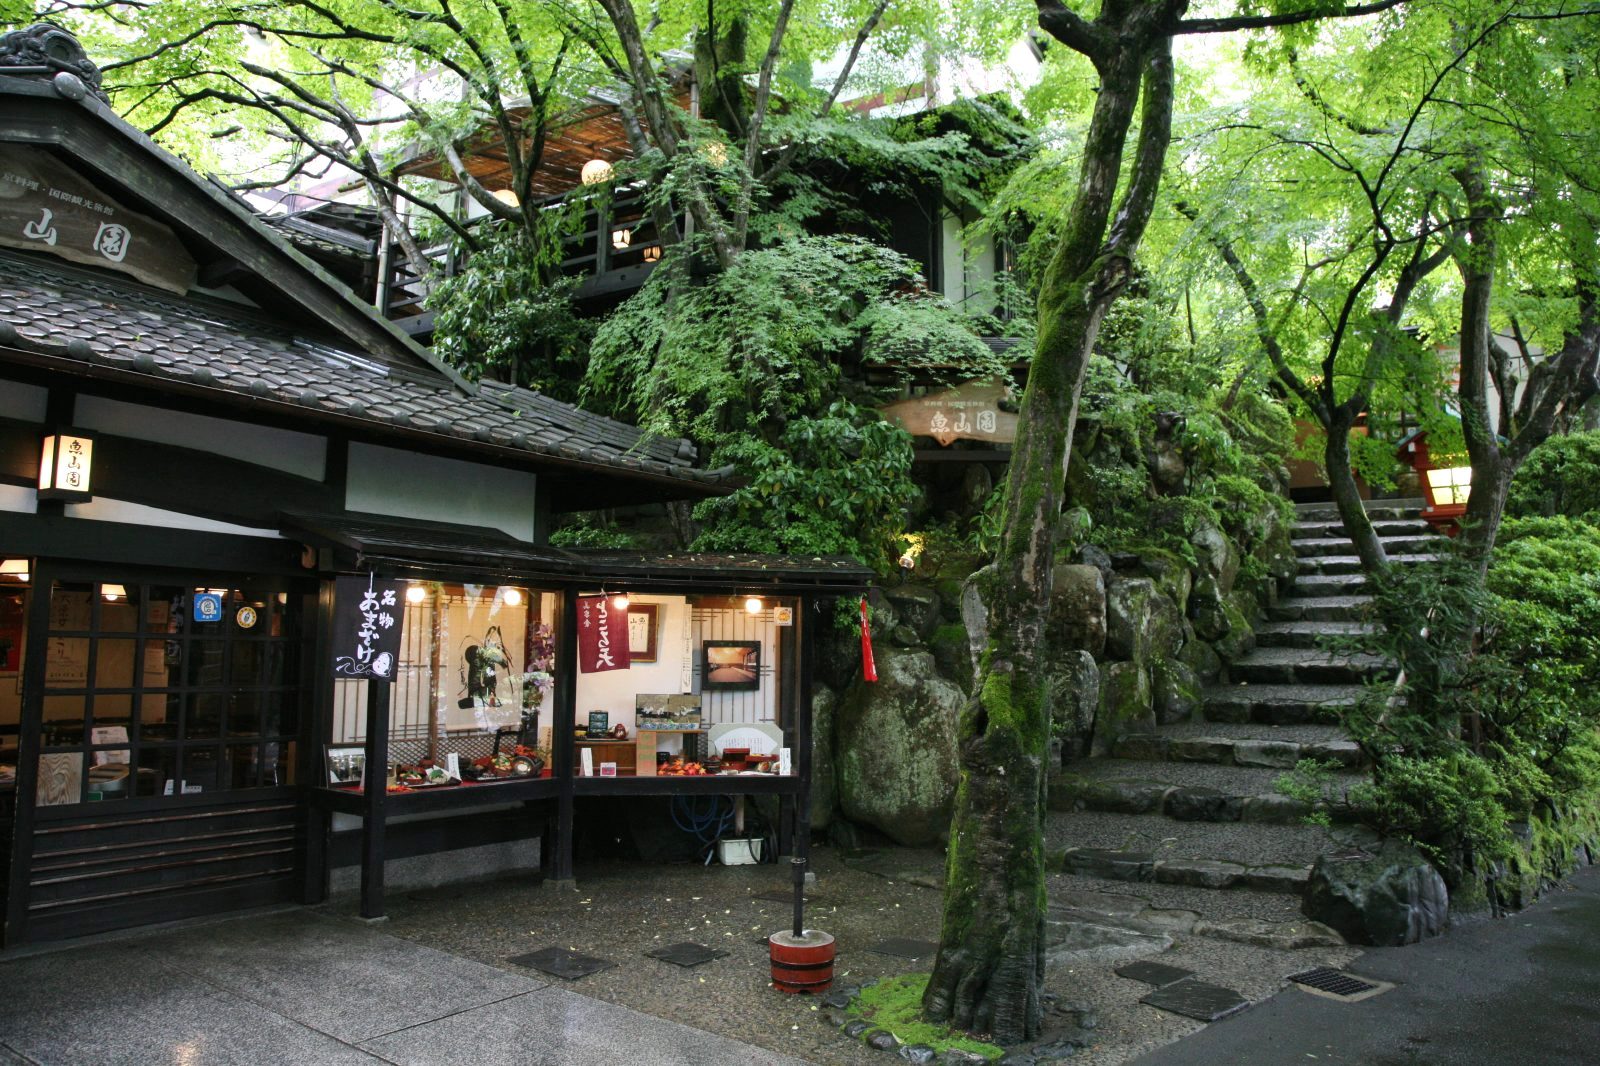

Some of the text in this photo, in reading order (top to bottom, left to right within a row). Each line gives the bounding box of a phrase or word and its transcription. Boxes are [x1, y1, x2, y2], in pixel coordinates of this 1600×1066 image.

[929, 410, 997, 434] 魚山園
[66, 439, 84, 488] 魚山園
[356, 590, 379, 664] あまざけ
[378, 589, 397, 628] 名物
